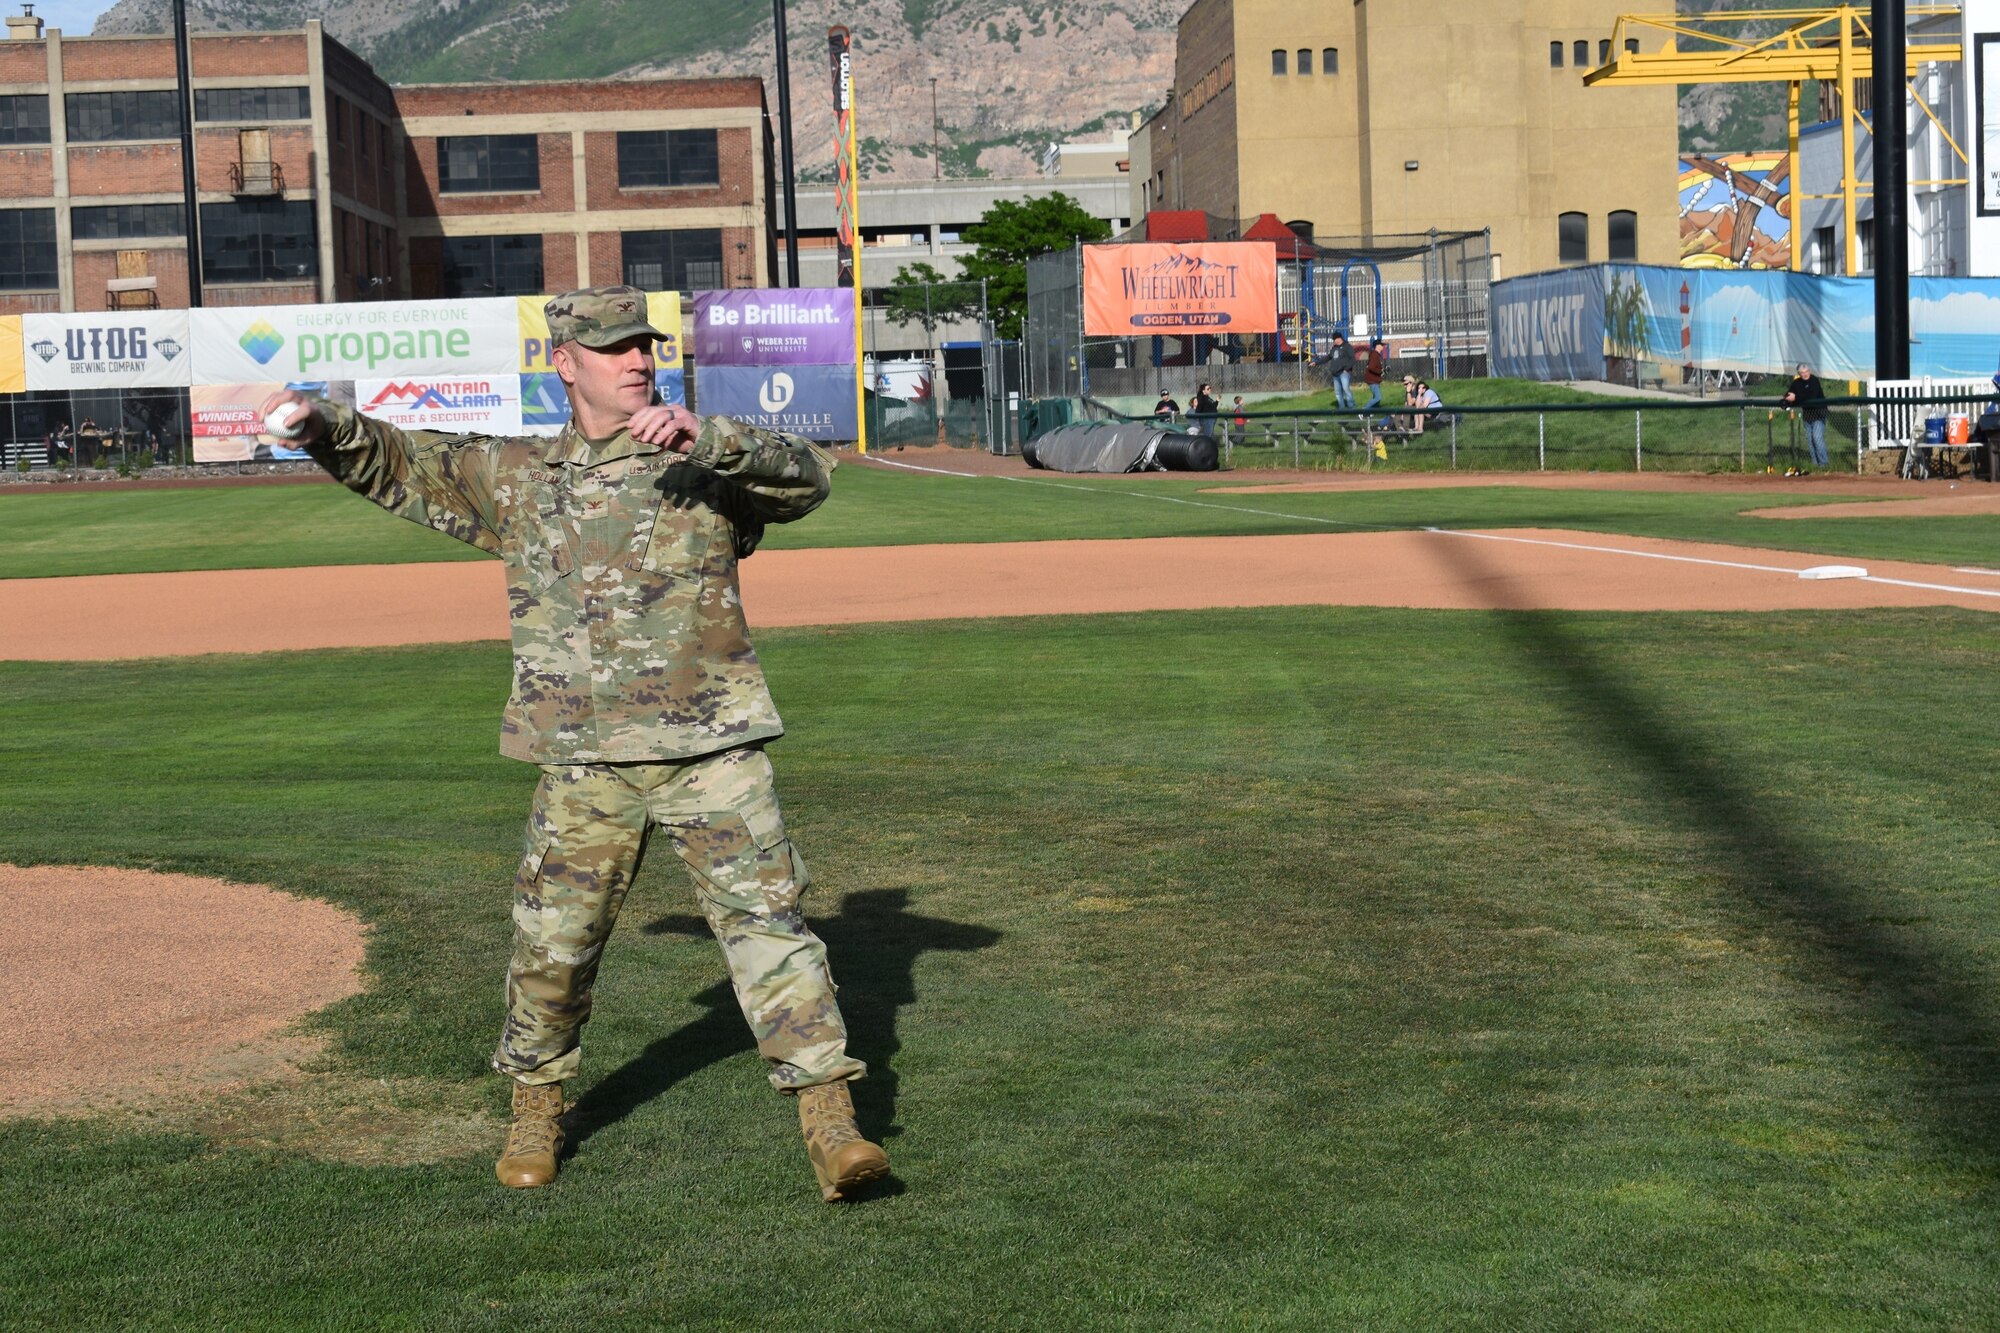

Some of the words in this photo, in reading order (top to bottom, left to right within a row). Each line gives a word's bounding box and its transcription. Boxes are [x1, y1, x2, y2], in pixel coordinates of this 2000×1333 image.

[1122, 266, 1238, 300] WHEELWRIGHT
[296, 312, 352, 326] ENERGY
[358, 309, 388, 324] FOR
[393, 307, 468, 322] EVERYONE
[709, 305, 739, 326] Be
[745, 304, 840, 325] Brilliant.
[1142, 314, 1186, 326] OGDEN,
[1189, 313, 1219, 324] UTAH
[1531, 294, 1585, 357] LIGHT
[65, 326, 147, 360] UTOG
[757, 337, 782, 345] WEBER
[785, 337, 807, 345] STATE
[297, 327, 471, 372] propane
[70, 362, 106, 373] BREWING
[108, 360, 146, 372] COMPANY
[198, 411, 254, 422] WINNERS
[388, 414, 416, 424] FIRE
[419, 413, 427, 422] &
[434, 412, 491, 421] SECURITY
[732, 413, 832, 425] ONNEVILLE
[207, 425, 232, 435] FIND
[234, 425, 243, 434] A
[646, 462, 660, 473] AIR
[661, 455, 685, 467] FORC
